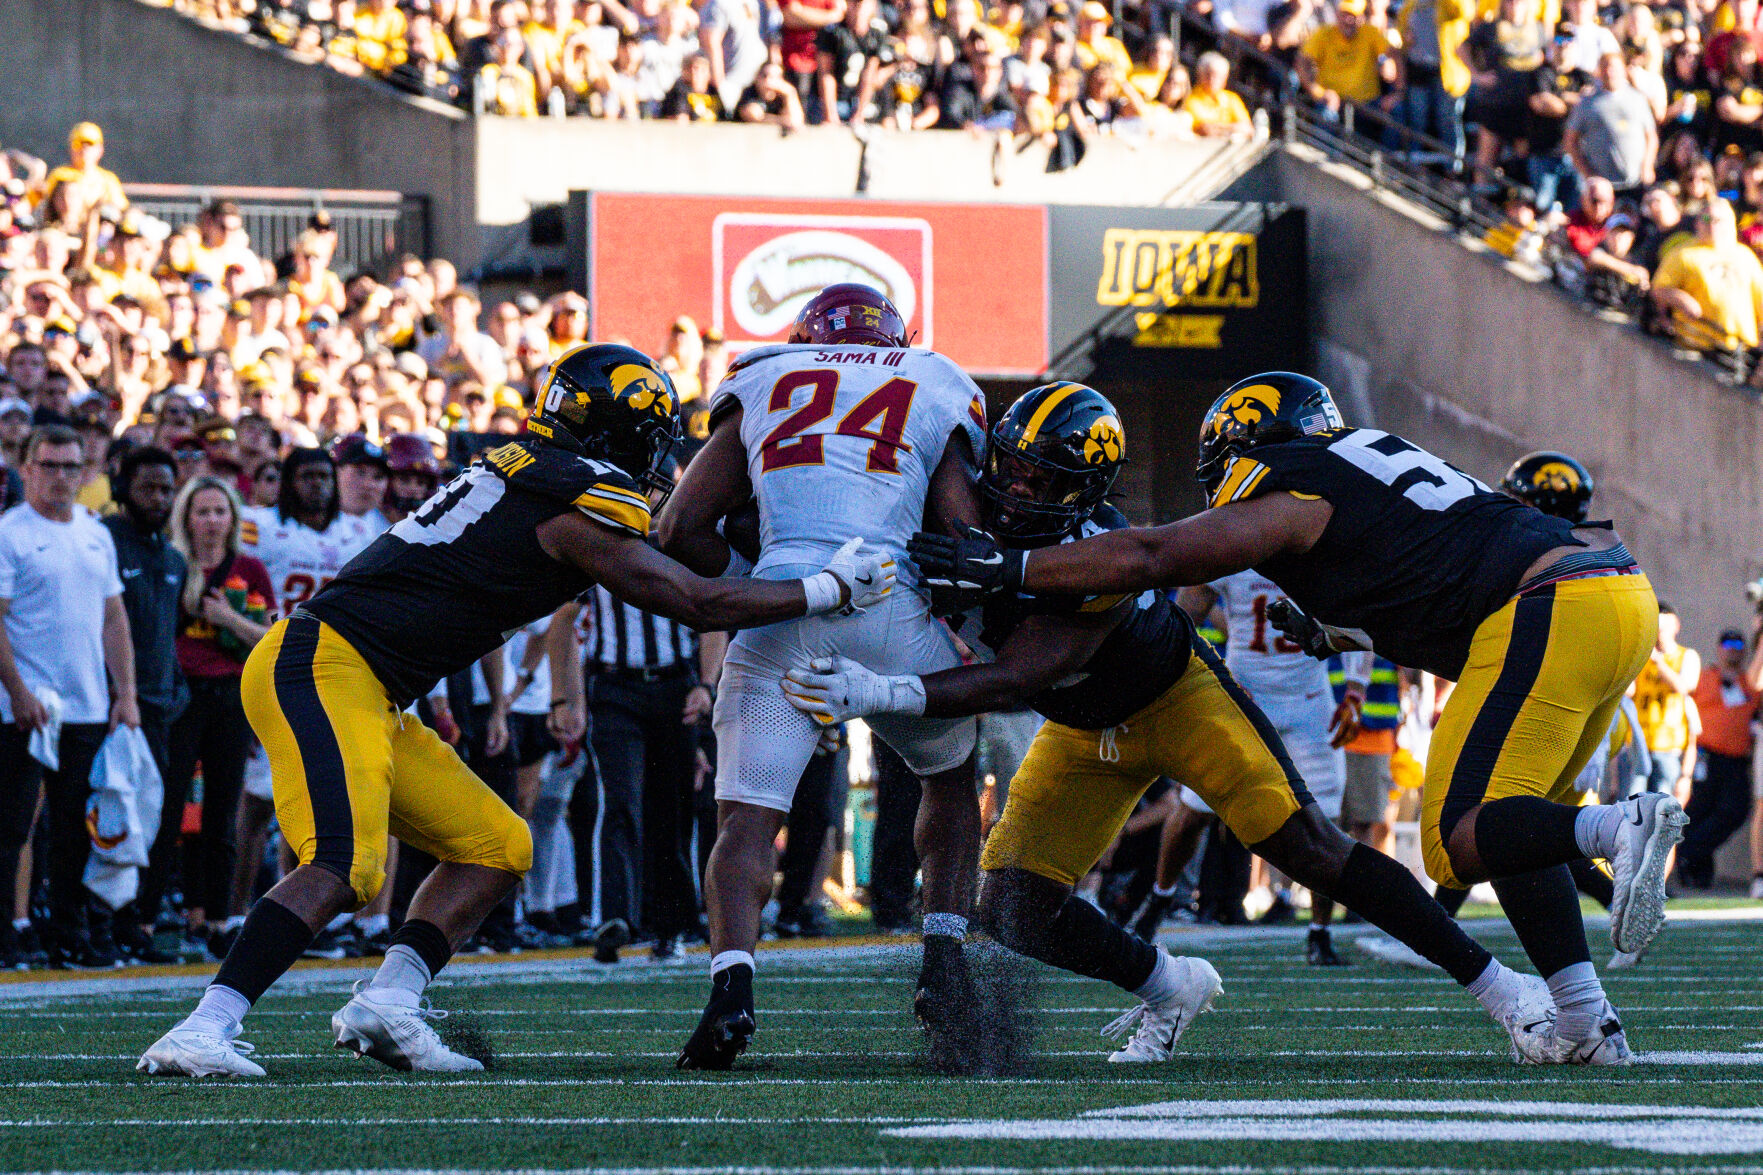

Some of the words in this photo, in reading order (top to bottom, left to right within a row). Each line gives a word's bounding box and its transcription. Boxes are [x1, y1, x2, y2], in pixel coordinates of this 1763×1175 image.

[1097, 228, 1259, 307] IOWA
[865, 317, 880, 328] 24
[814, 351, 878, 365] SAMA
[882, 352, 906, 367] III
[545, 384, 565, 412] 0
[760, 369, 919, 478] 24
[1327, 428, 1494, 512] 5
[384, 460, 506, 547] 0
[284, 573, 335, 616] 2
